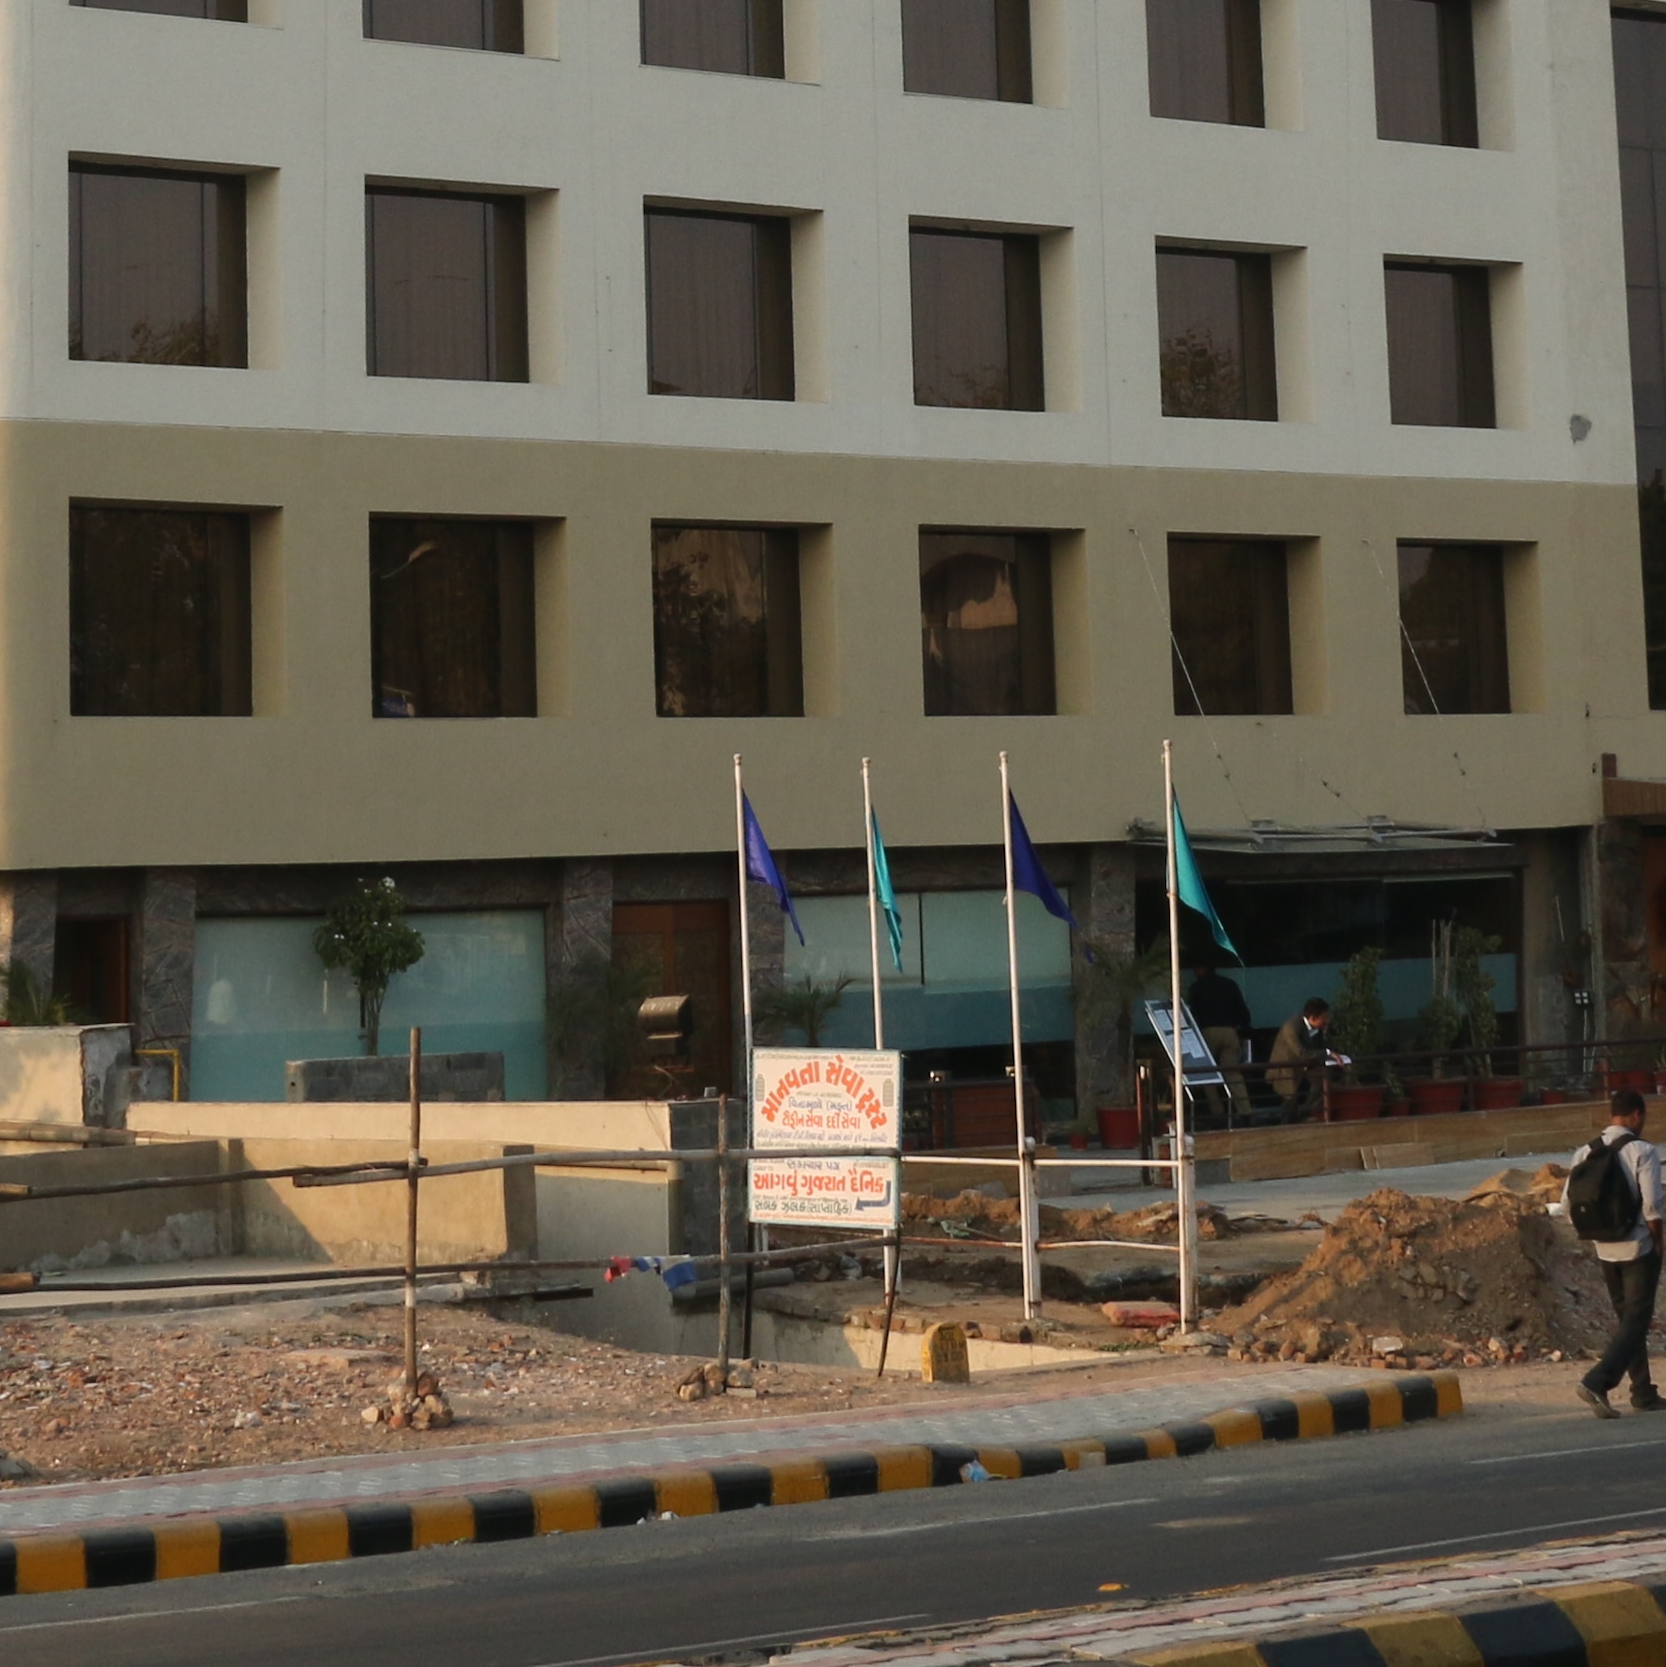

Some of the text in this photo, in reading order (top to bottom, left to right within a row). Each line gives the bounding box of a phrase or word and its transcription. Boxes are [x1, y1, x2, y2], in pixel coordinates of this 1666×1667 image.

[761, 1061, 820, 1122] માનવતા
[826, 1054, 864, 1099] સેવા
[801, 1175, 846, 1195] ગુજરાત
